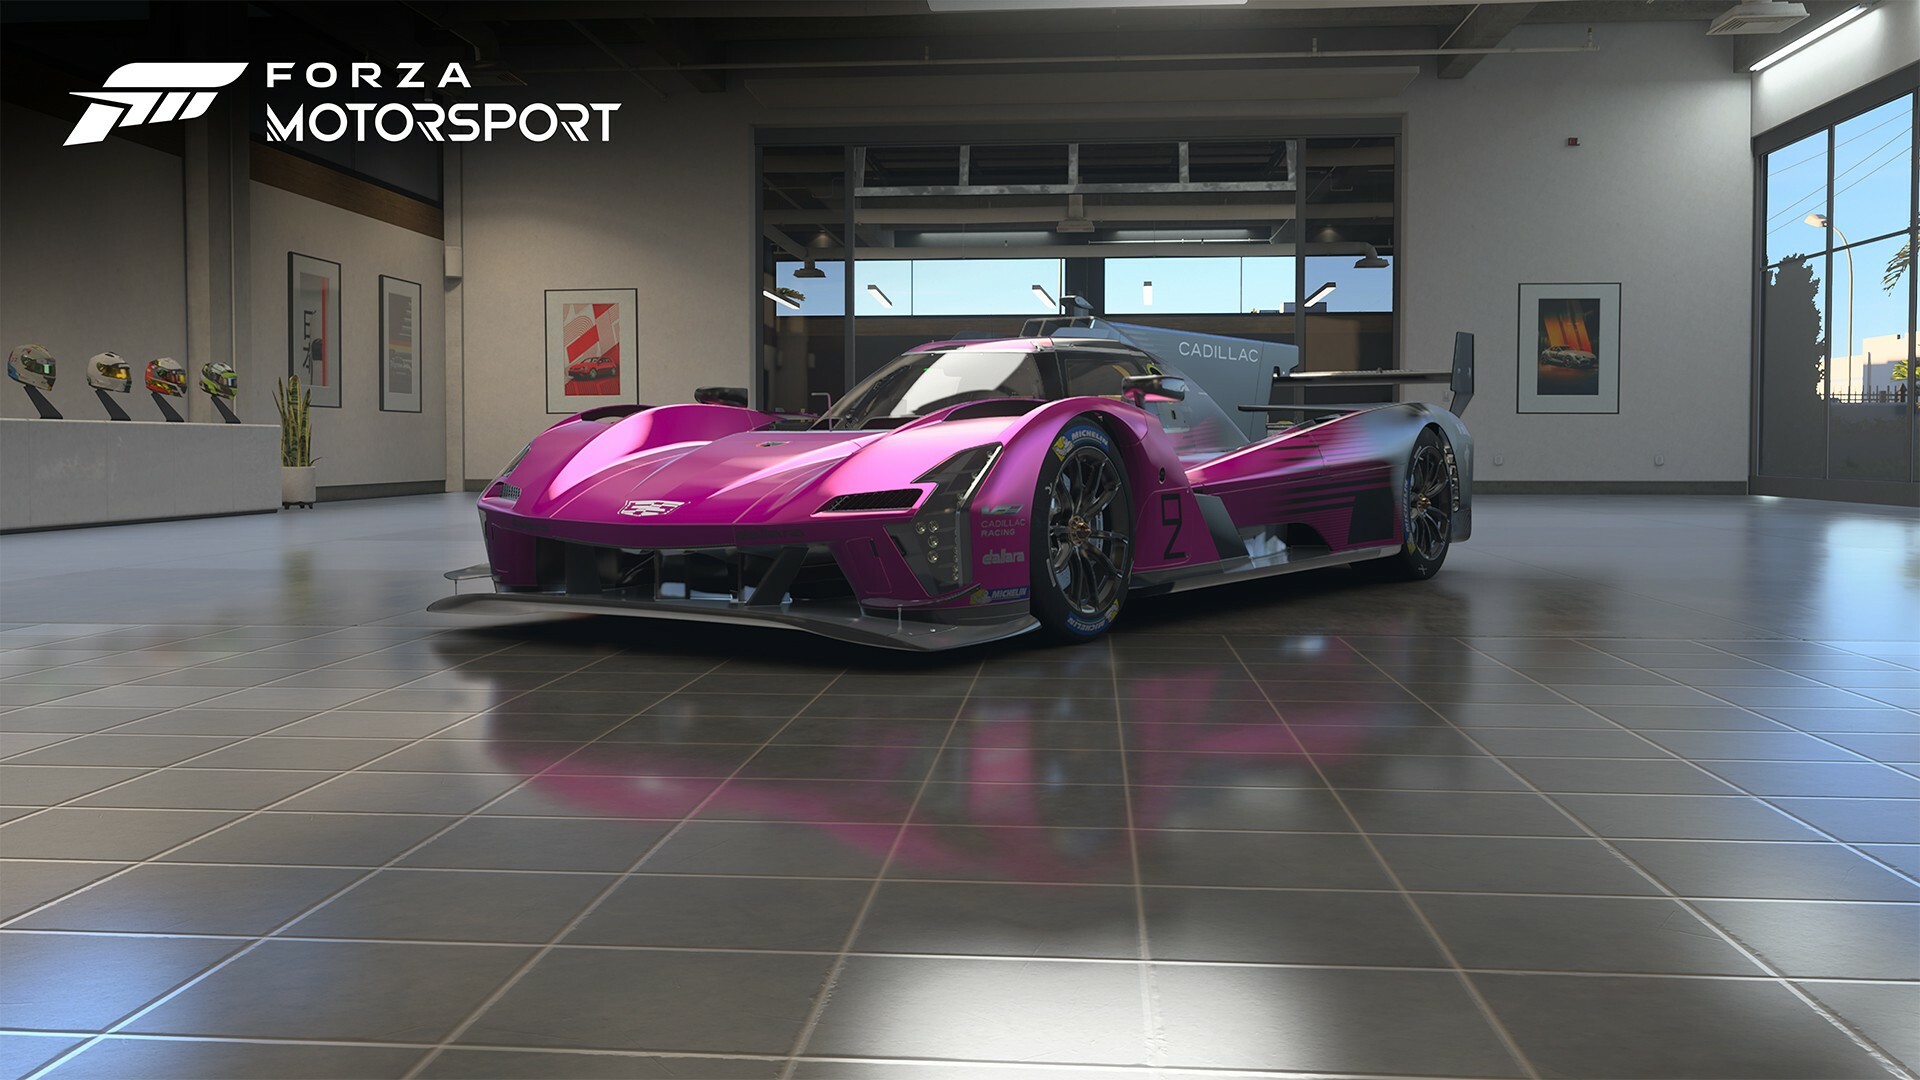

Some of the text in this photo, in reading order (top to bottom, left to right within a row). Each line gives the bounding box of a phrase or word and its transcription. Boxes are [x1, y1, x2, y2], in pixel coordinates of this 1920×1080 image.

[1178, 341, 1259, 362] CADILLAC
[1071, 430, 1109, 445] MICHELIN
[981, 518, 1026, 528] CADILLAC
[981, 529, 1016, 537] RACING
[982, 549, 1025, 565] dallara
[991, 587, 1028, 599] MICHELIN
[1067, 617, 1106, 631] MICHELIN
